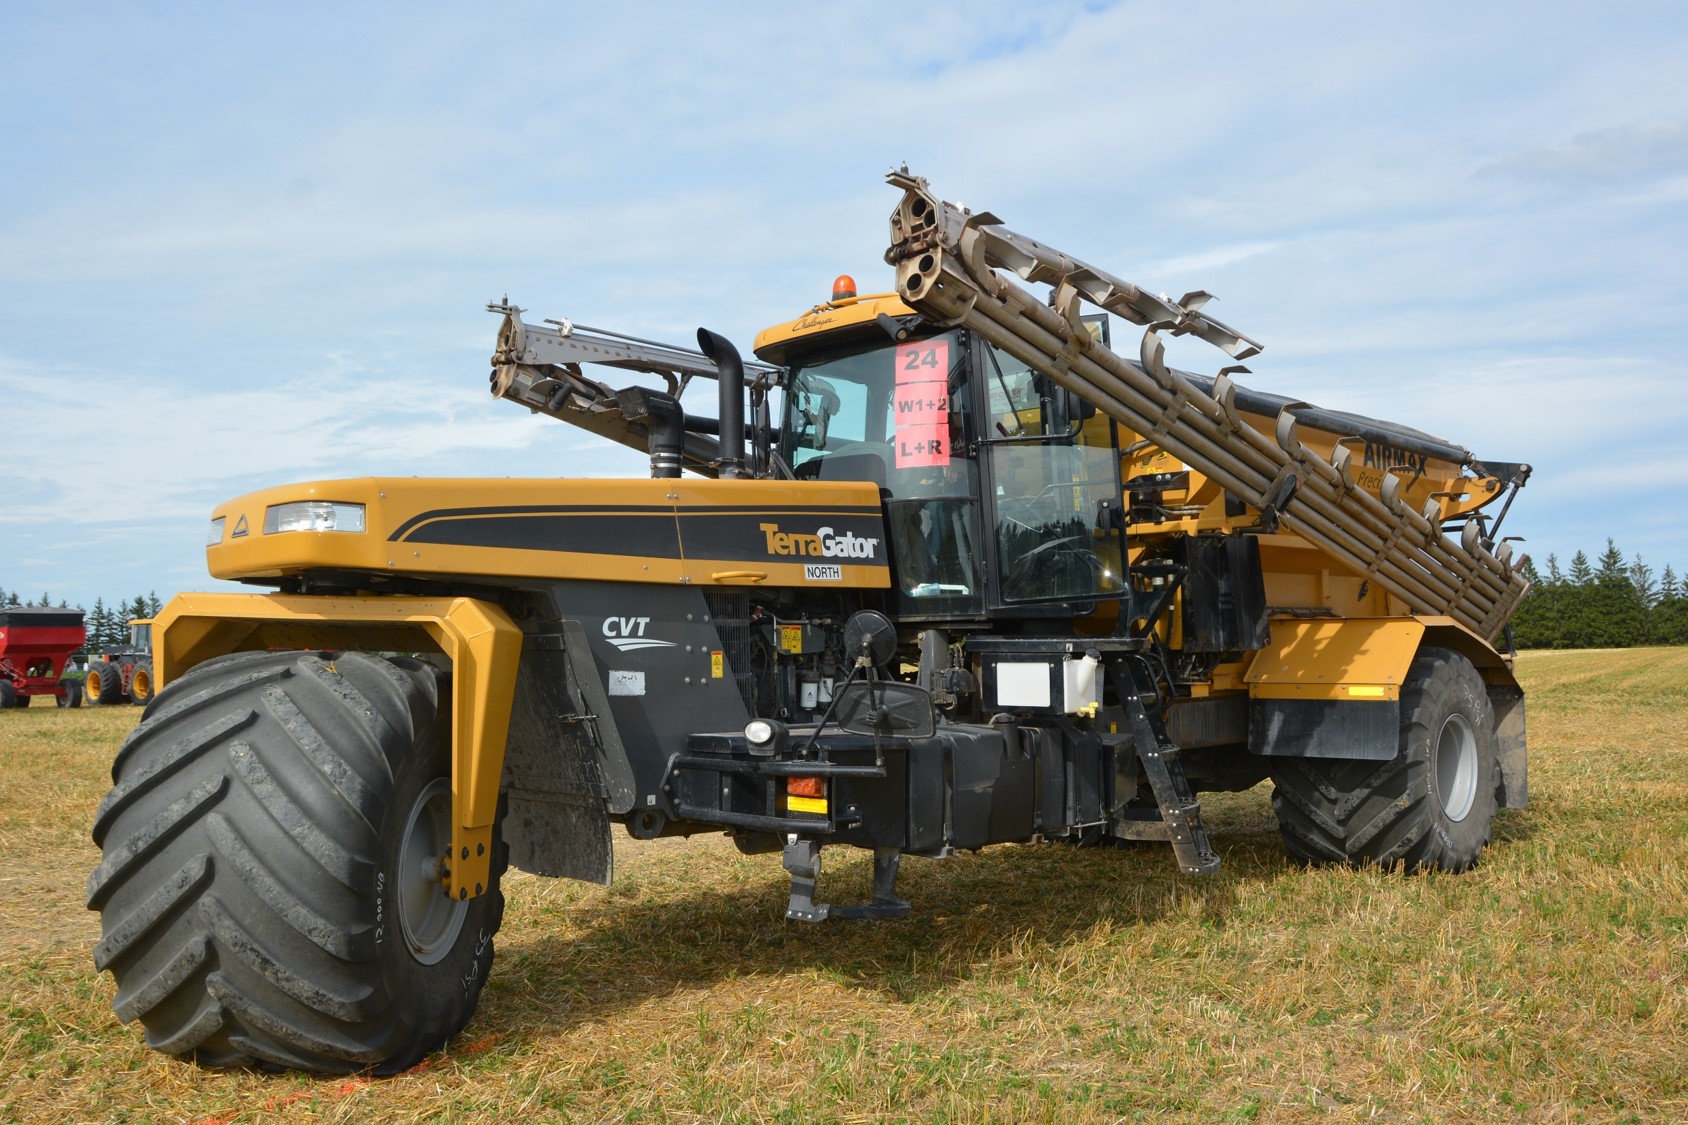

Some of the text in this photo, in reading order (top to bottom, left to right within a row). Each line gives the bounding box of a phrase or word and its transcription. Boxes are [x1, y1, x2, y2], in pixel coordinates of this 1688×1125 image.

[904, 348, 938, 370] 24
[898, 398, 946, 413] W1+2
[901, 440, 942, 457] L+R
[1363, 440, 1428, 492] AIRMAX
[1356, 471, 1381, 489] Preci
[760, 522, 878, 559] TerraGator
[806, 566, 840, 579] NORTH
[602, 616, 651, 637] CVT
